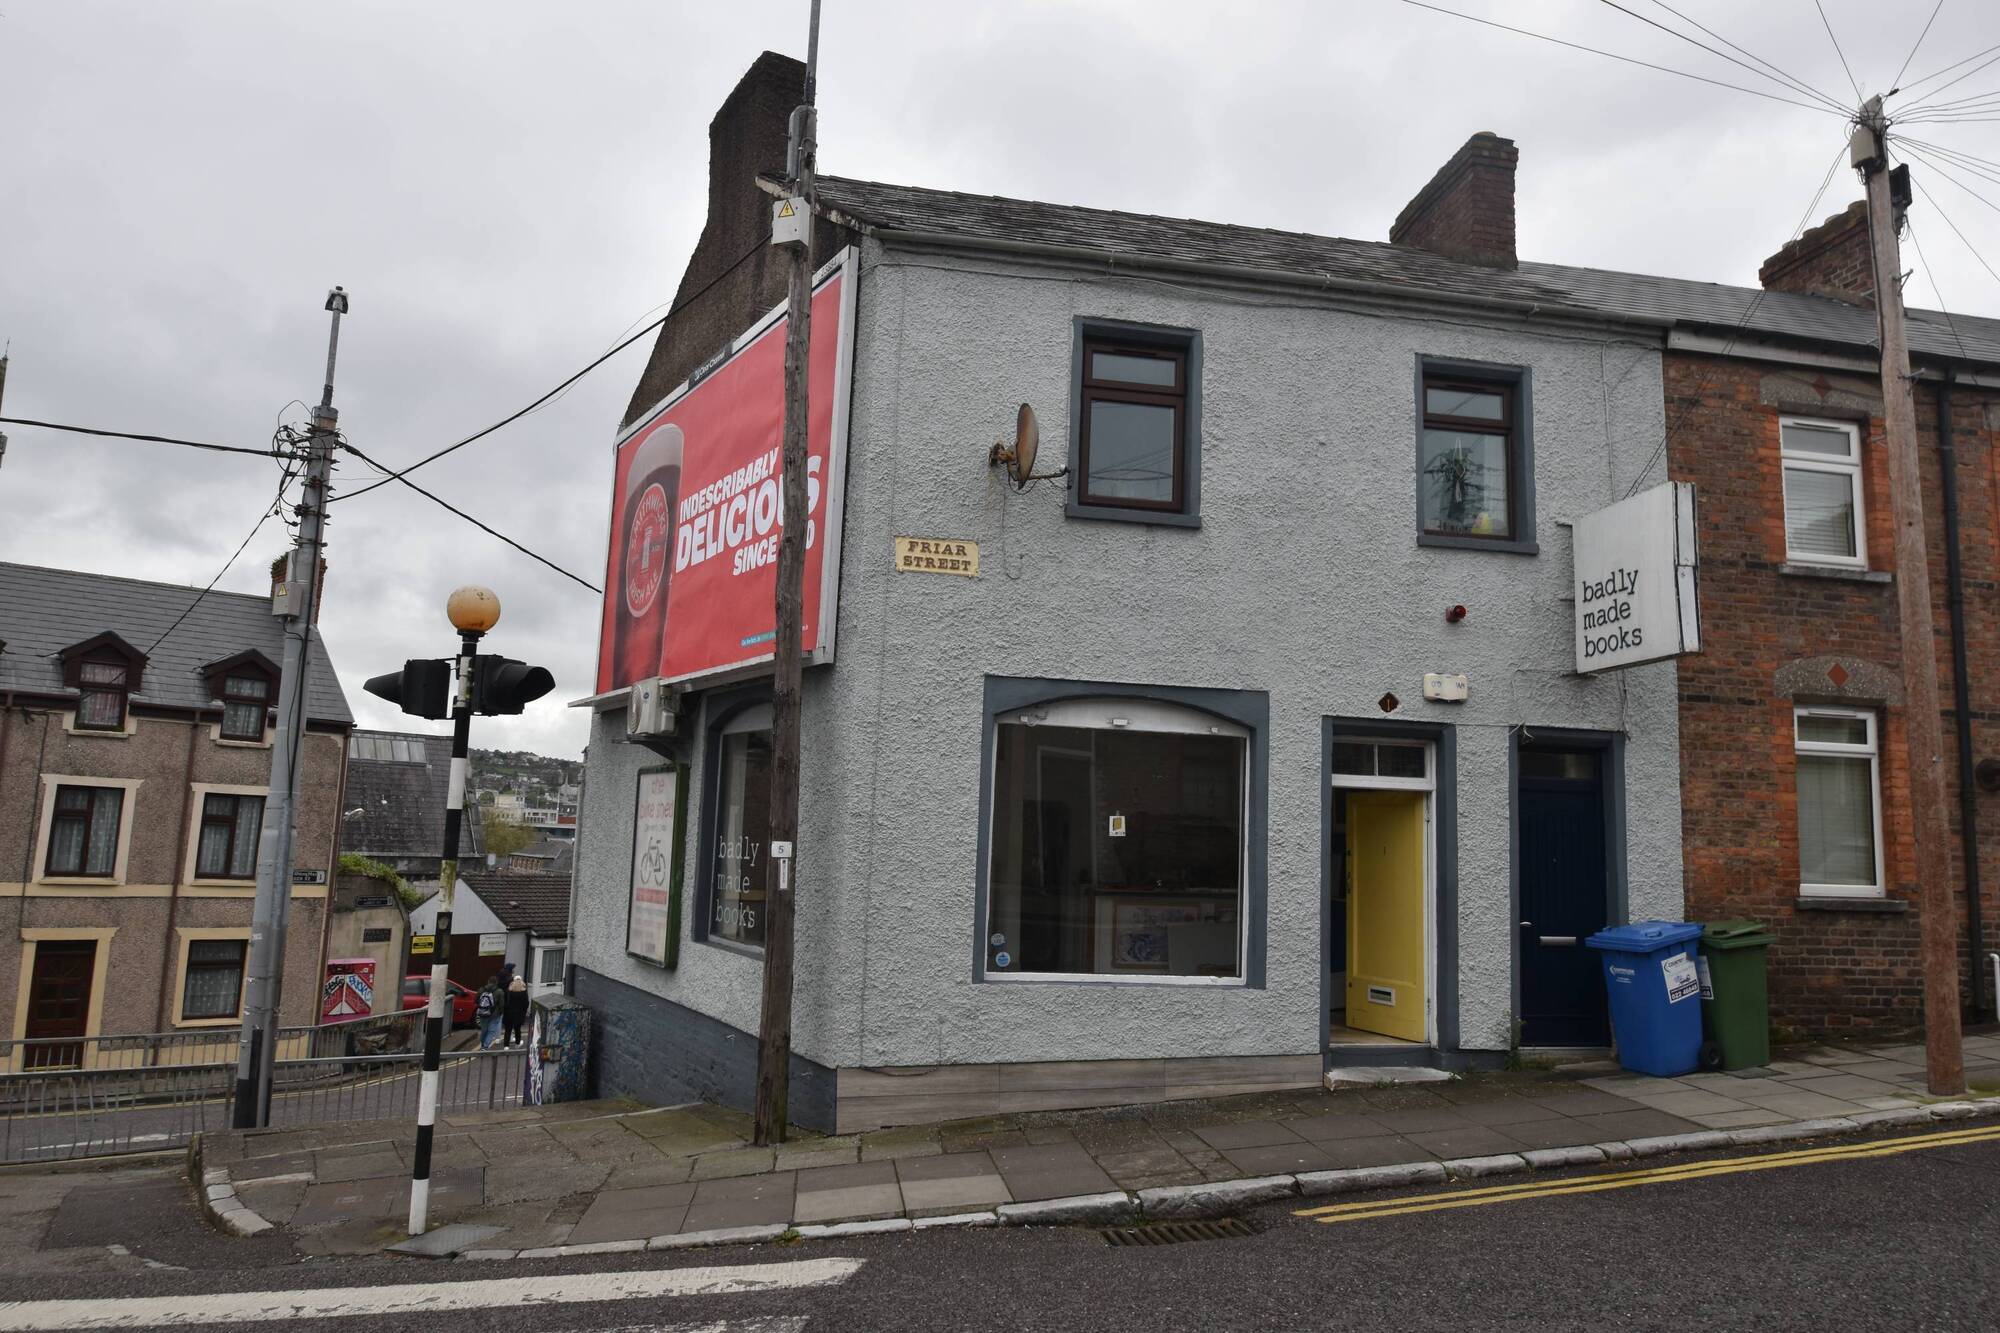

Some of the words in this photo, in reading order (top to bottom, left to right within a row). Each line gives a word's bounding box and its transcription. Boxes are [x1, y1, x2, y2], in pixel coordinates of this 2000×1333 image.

[680, 446, 780, 524] INDESCRIBABLY
[676, 455, 822, 573] DELICIOS
[732, 534, 778, 576] SINCE
[903, 555, 971, 571] STREET
[908, 541, 947, 556] FRIAR
[1582, 568, 1639, 603] badly
[1583, 598, 1631, 630] made
[1584, 626, 1643, 658] books
[718, 836, 759, 867] badly
[778, 845, 785, 855] 5
[717, 869, 750, 894] made
[715, 899, 755, 929] books
